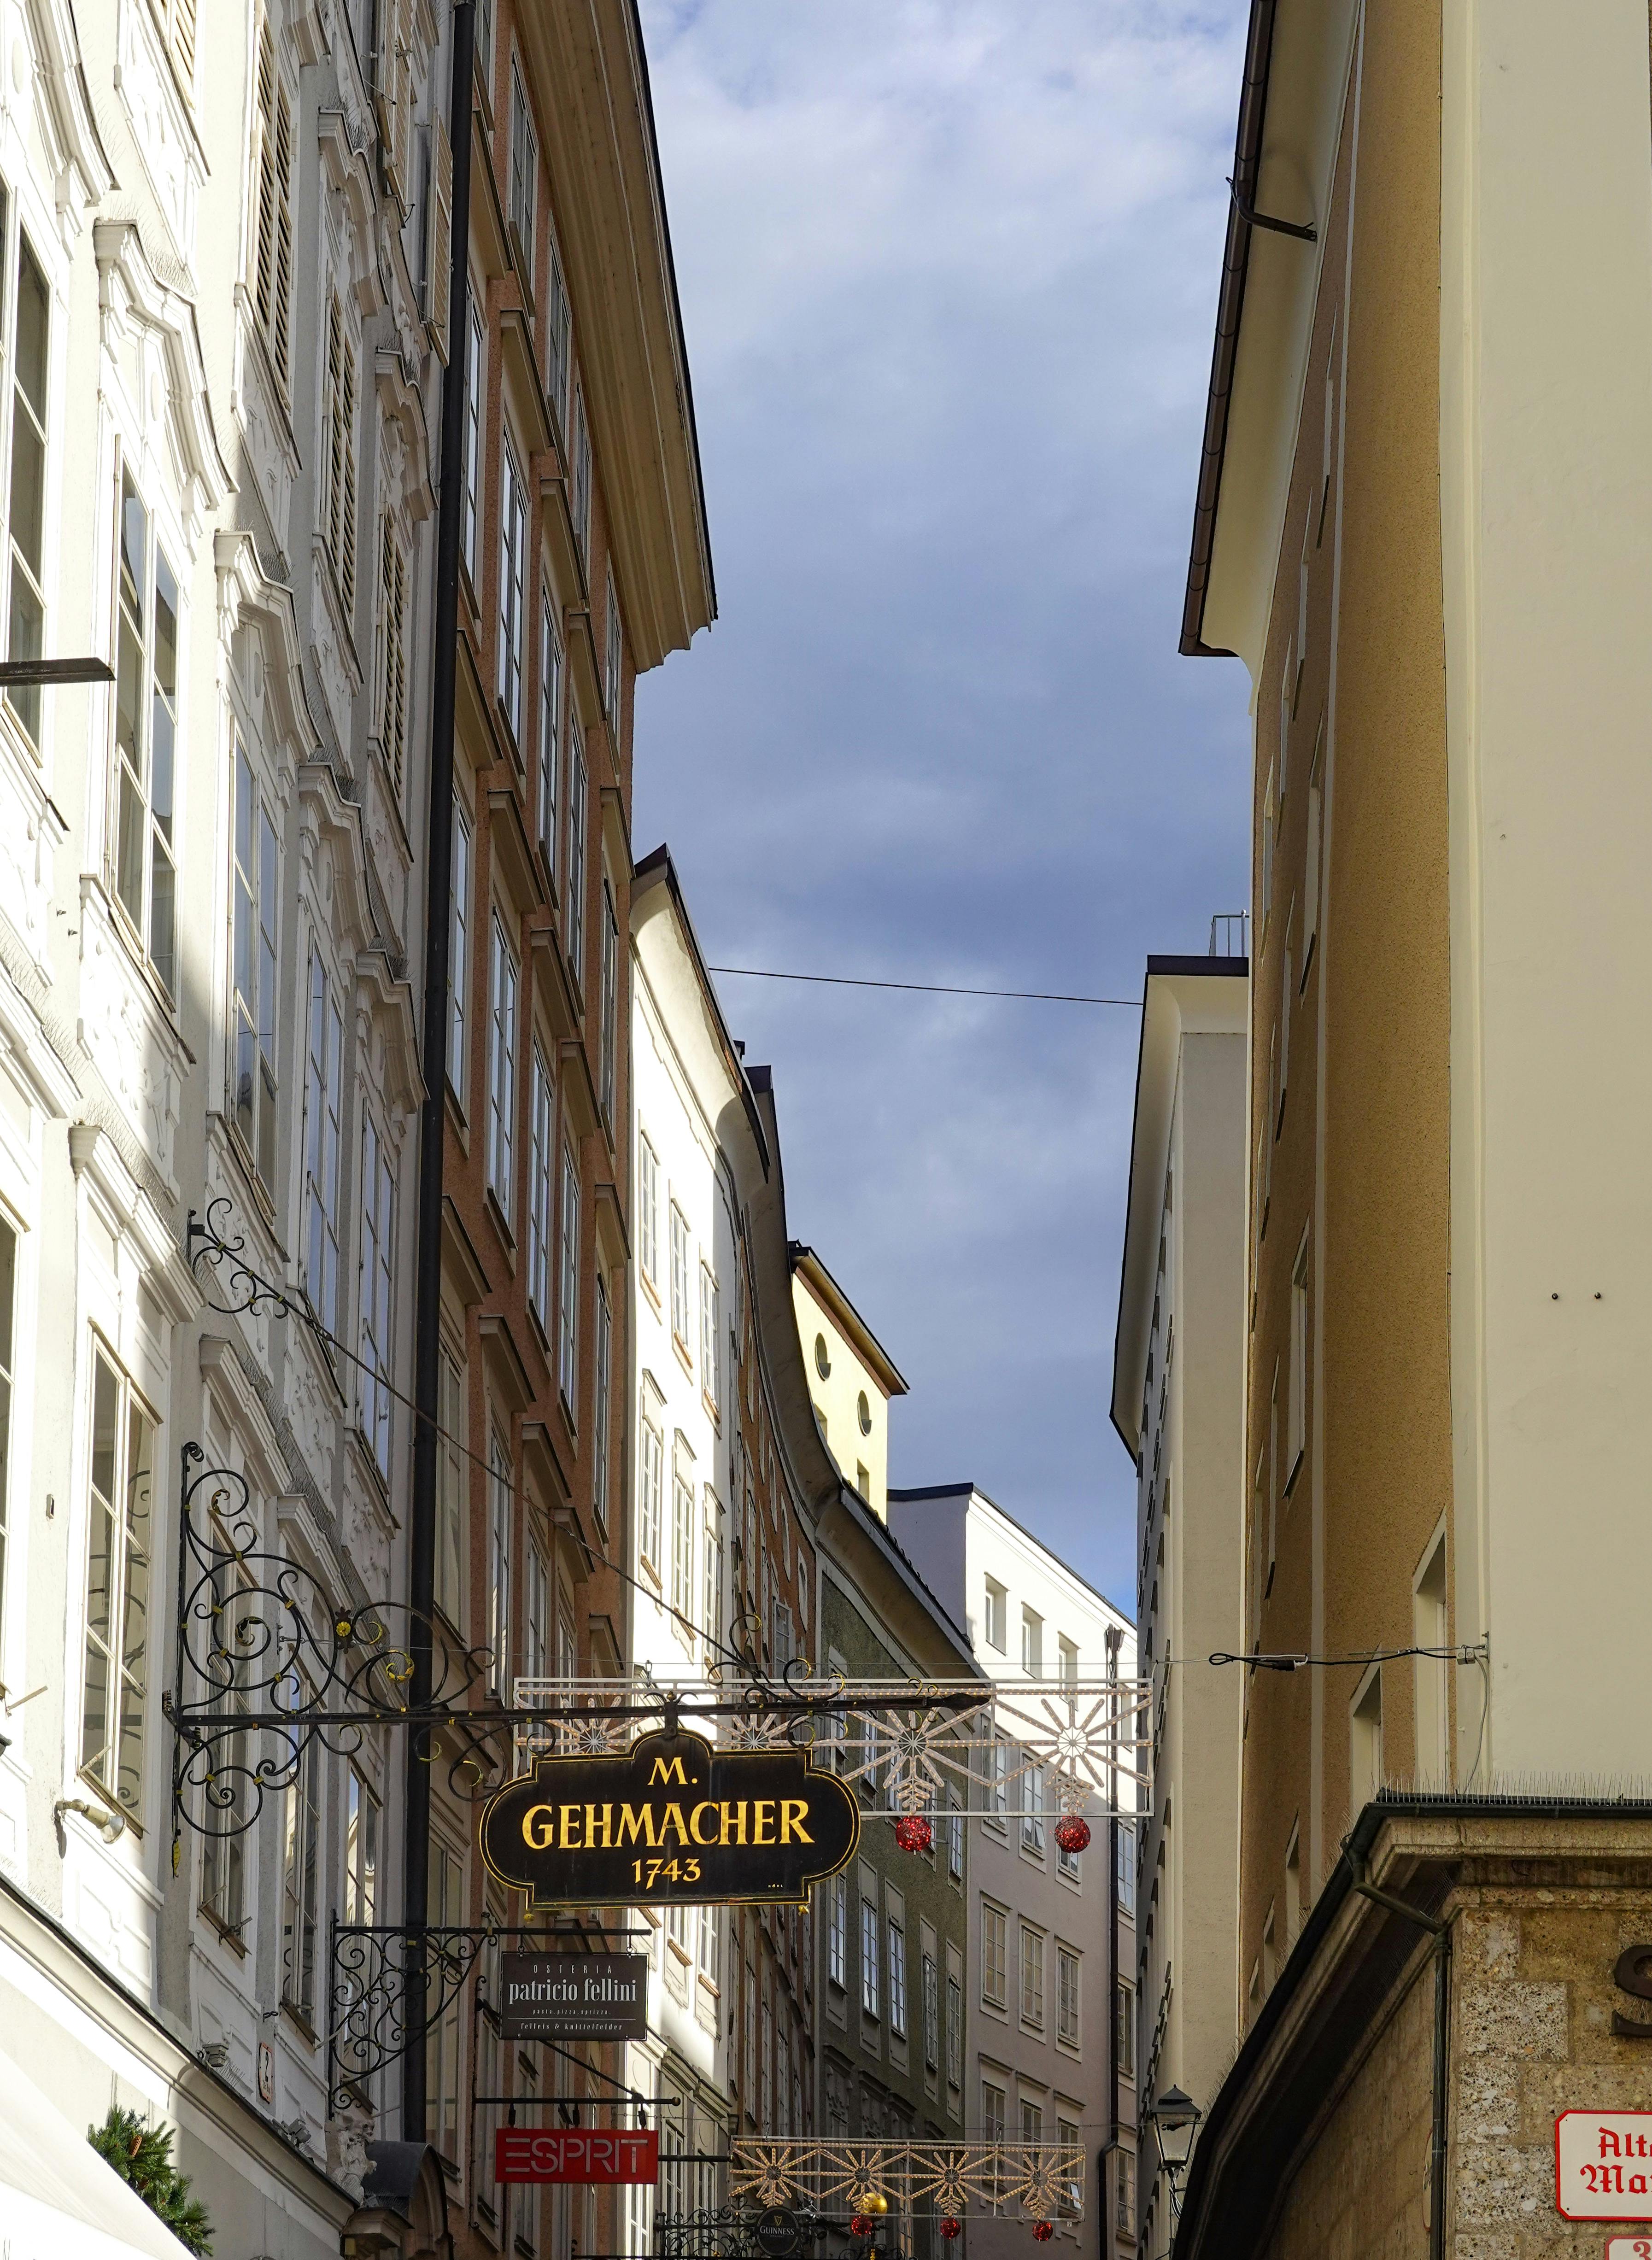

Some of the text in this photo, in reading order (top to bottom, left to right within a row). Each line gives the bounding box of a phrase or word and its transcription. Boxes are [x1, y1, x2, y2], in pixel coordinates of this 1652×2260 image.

[647, 1756, 698, 1786] M.
[521, 1799, 816, 1850] GEHMACHER
[631, 1857, 701, 1890] 1743
[533, 1964, 612, 1974] OSTERIA
[508, 1978, 637, 2005] patricio fellini
[505, 2137, 648, 2174] ESPRIT
[1598, 2126, 1652, 2159] Alt
[1580, 2163, 1652, 2194] Ma
[760, 2225, 795, 2235] GUINNESS
